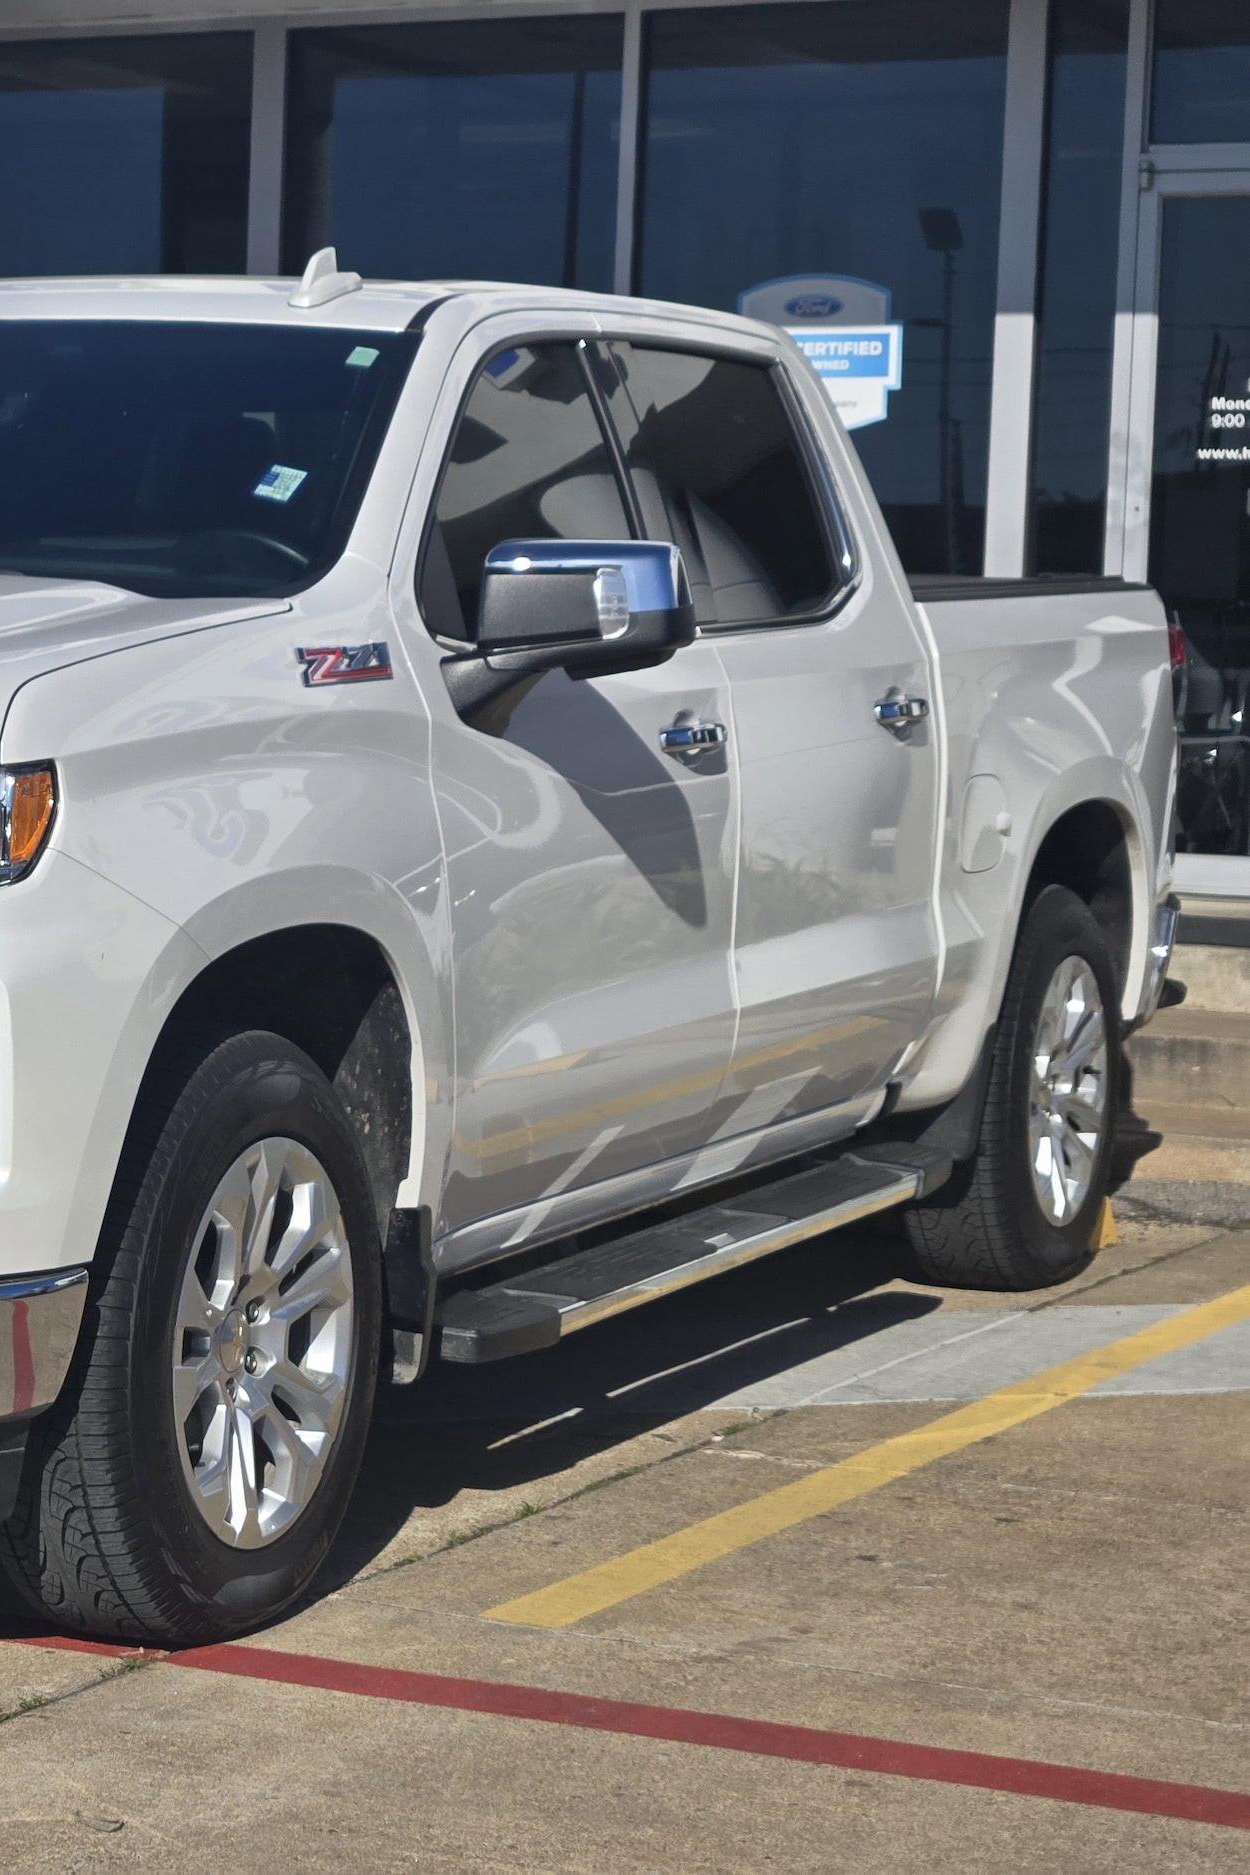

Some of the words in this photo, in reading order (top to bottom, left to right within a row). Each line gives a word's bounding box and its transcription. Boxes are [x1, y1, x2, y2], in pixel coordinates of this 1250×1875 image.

[811, 359, 850, 371] WNED
[1211, 413, 1246, 428] 9:00
[295, 642, 394, 688] Z71
